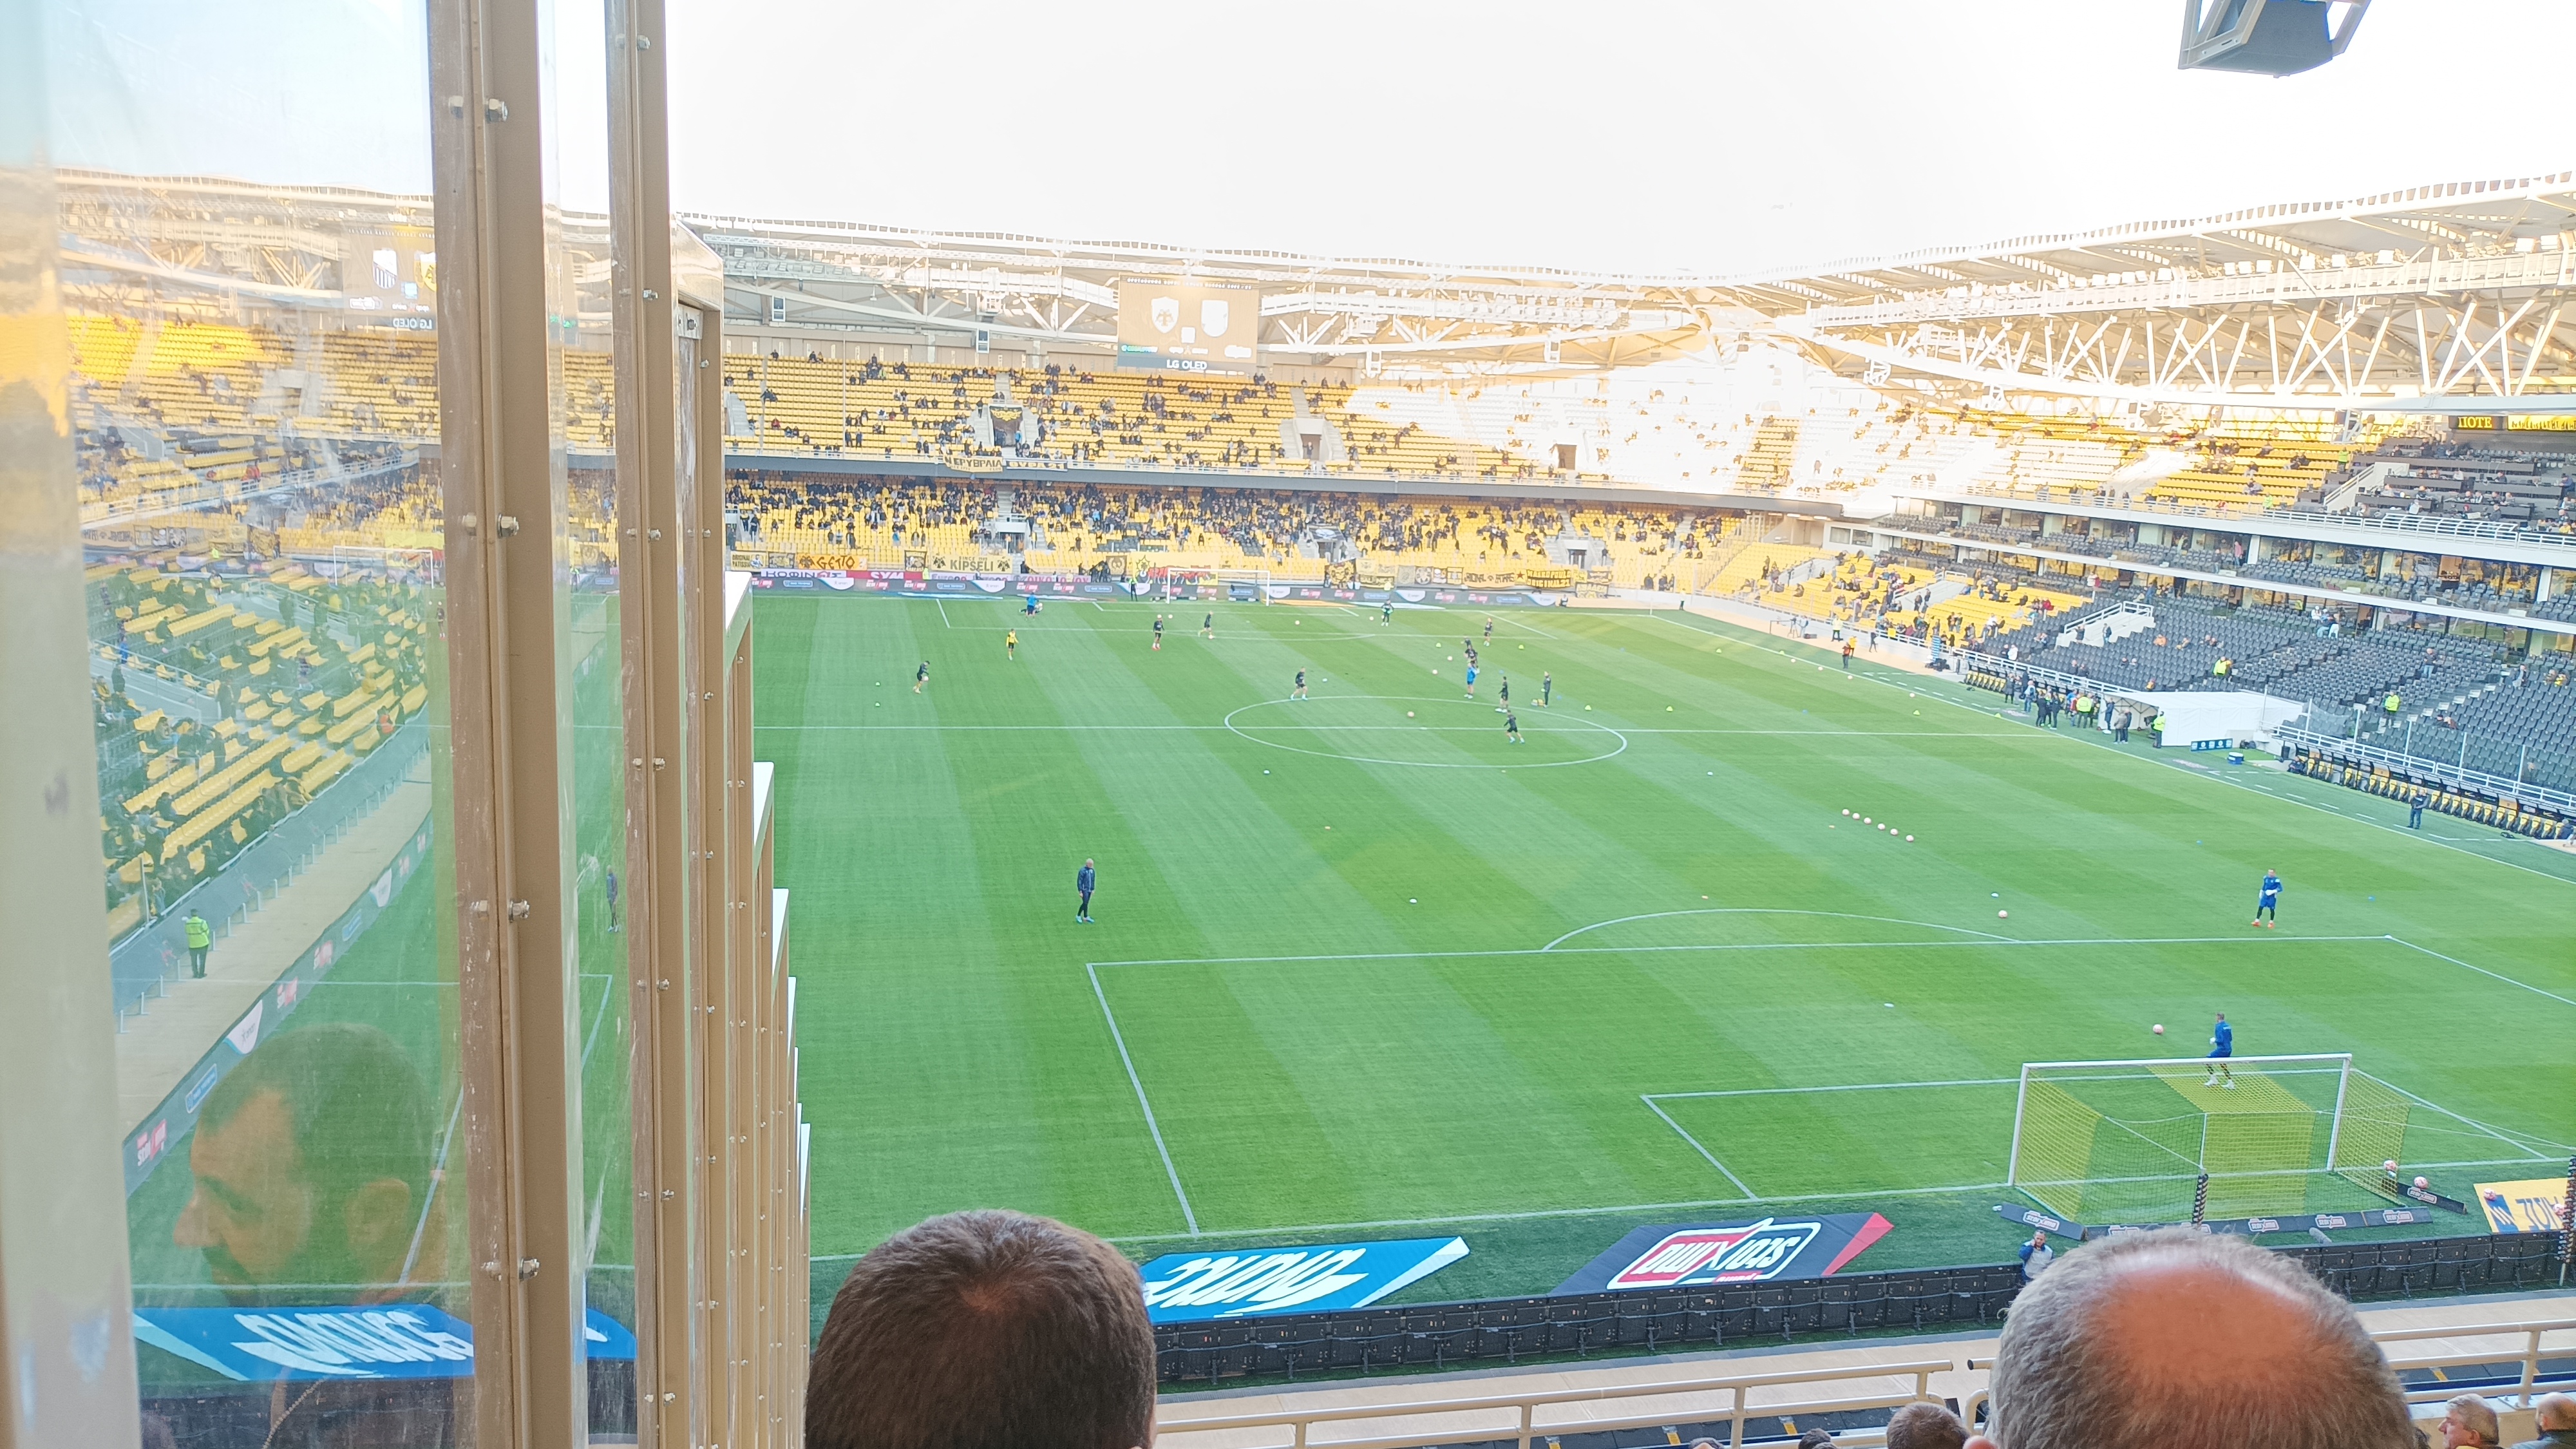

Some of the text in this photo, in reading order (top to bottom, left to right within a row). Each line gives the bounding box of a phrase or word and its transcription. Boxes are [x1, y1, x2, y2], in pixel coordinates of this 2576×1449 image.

[1166, 359, 1208, 370] LG OLED
[817, 555, 855, 570] GETTO
[950, 560, 994, 571] KIPSELI
